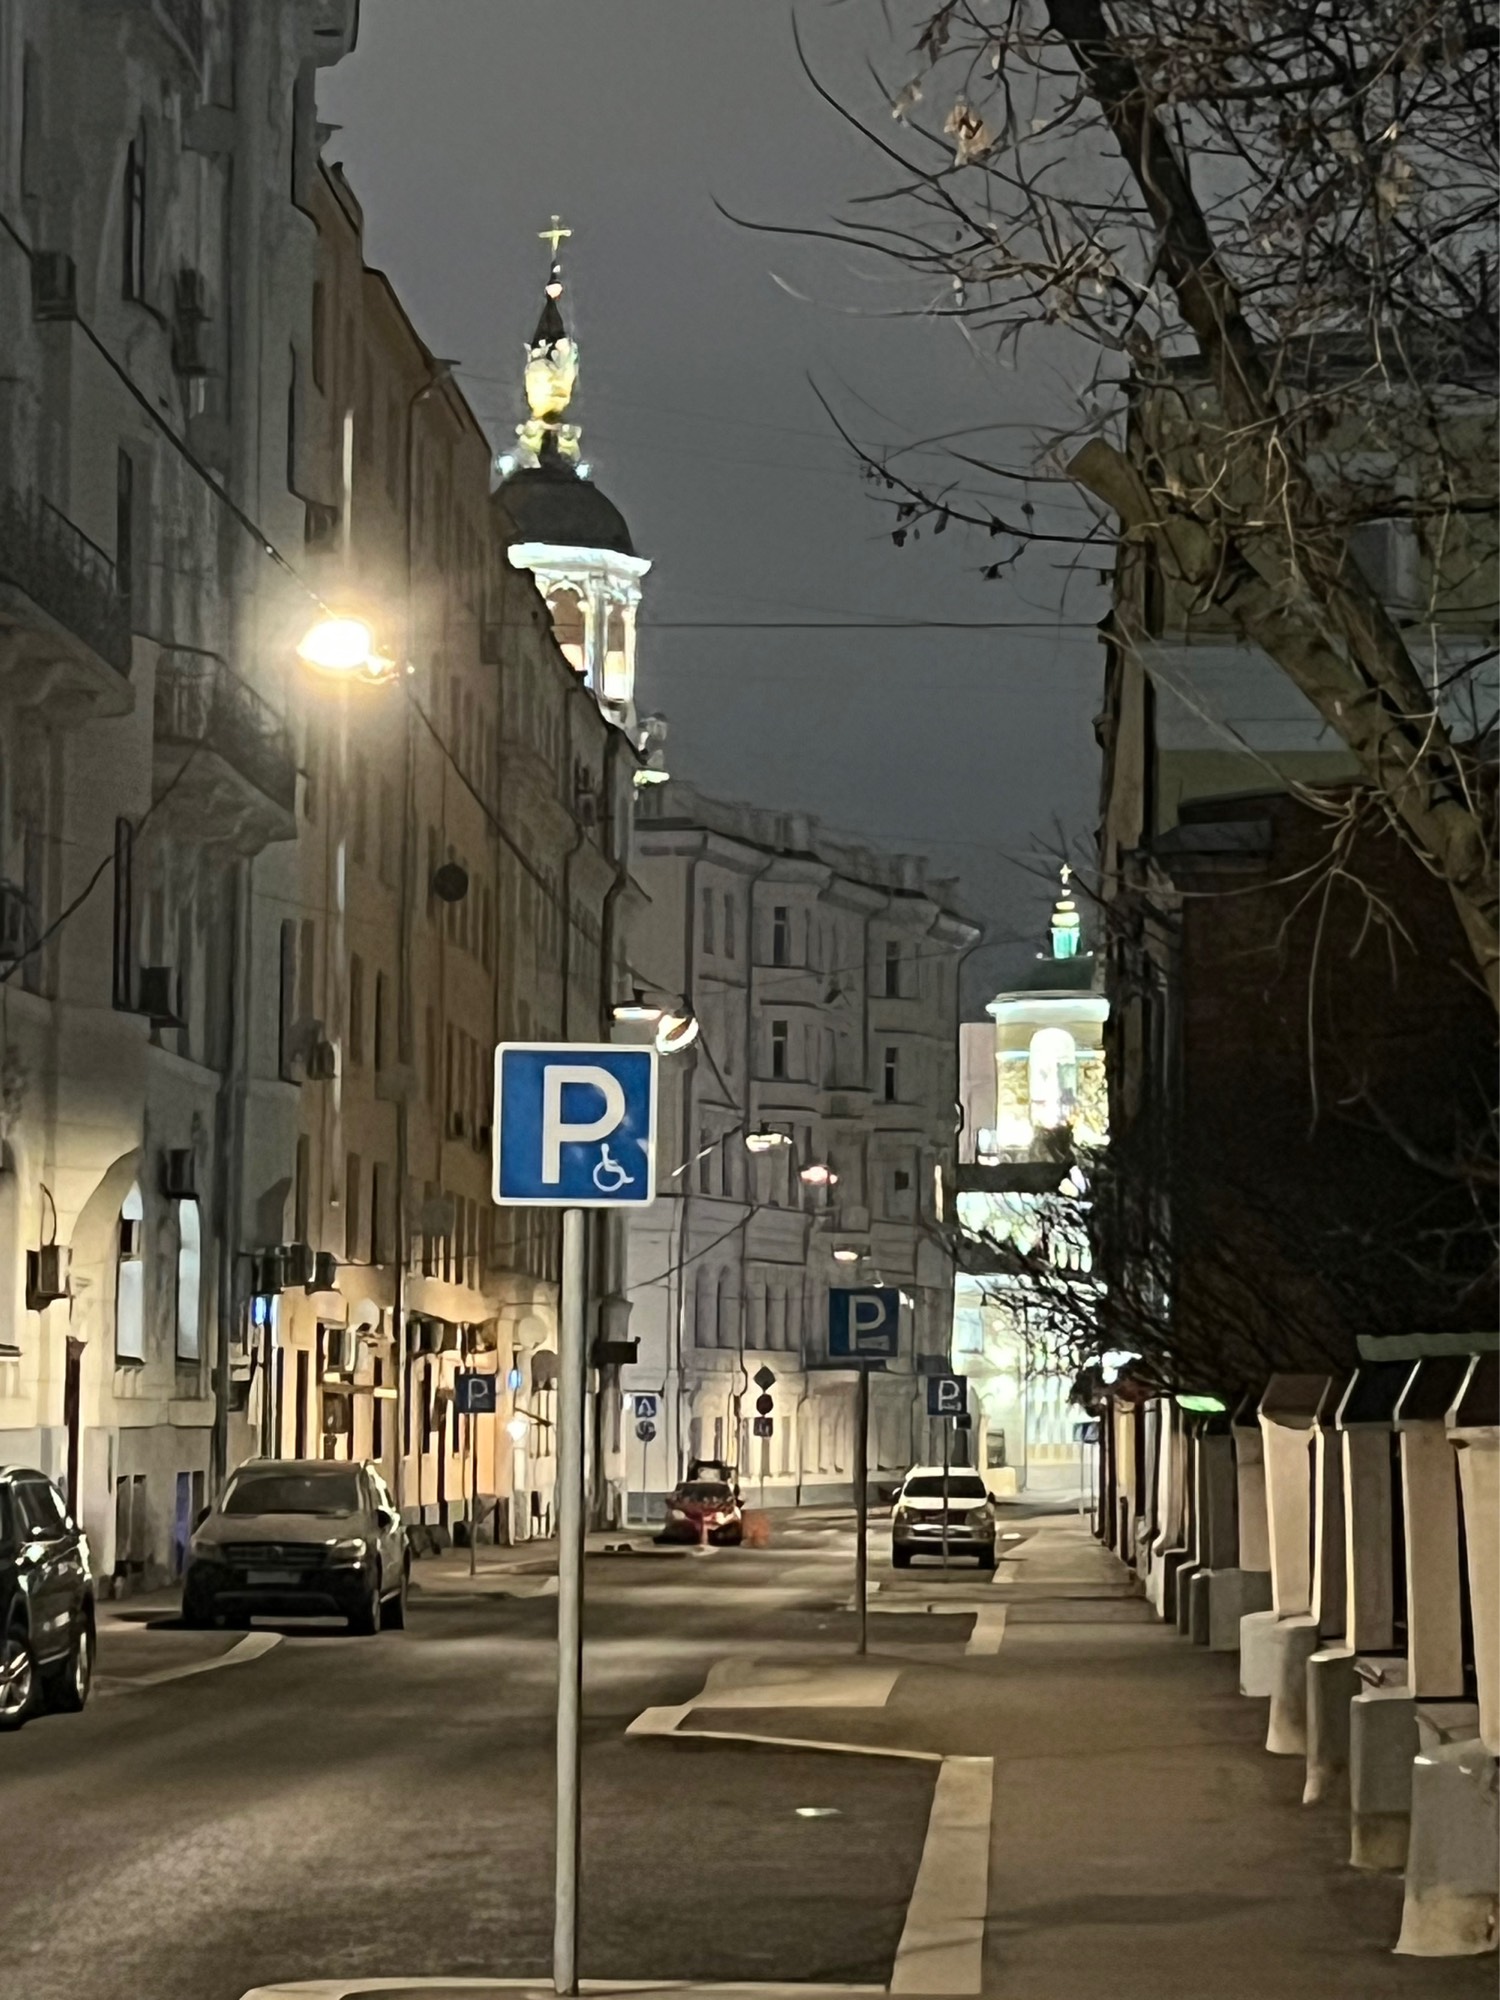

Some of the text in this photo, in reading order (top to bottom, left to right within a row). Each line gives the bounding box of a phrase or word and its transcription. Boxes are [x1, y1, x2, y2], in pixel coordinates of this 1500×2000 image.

[541, 1065, 625, 1184] P
[848, 1295, 886, 1351] P
[938, 1380, 960, 1411] P
